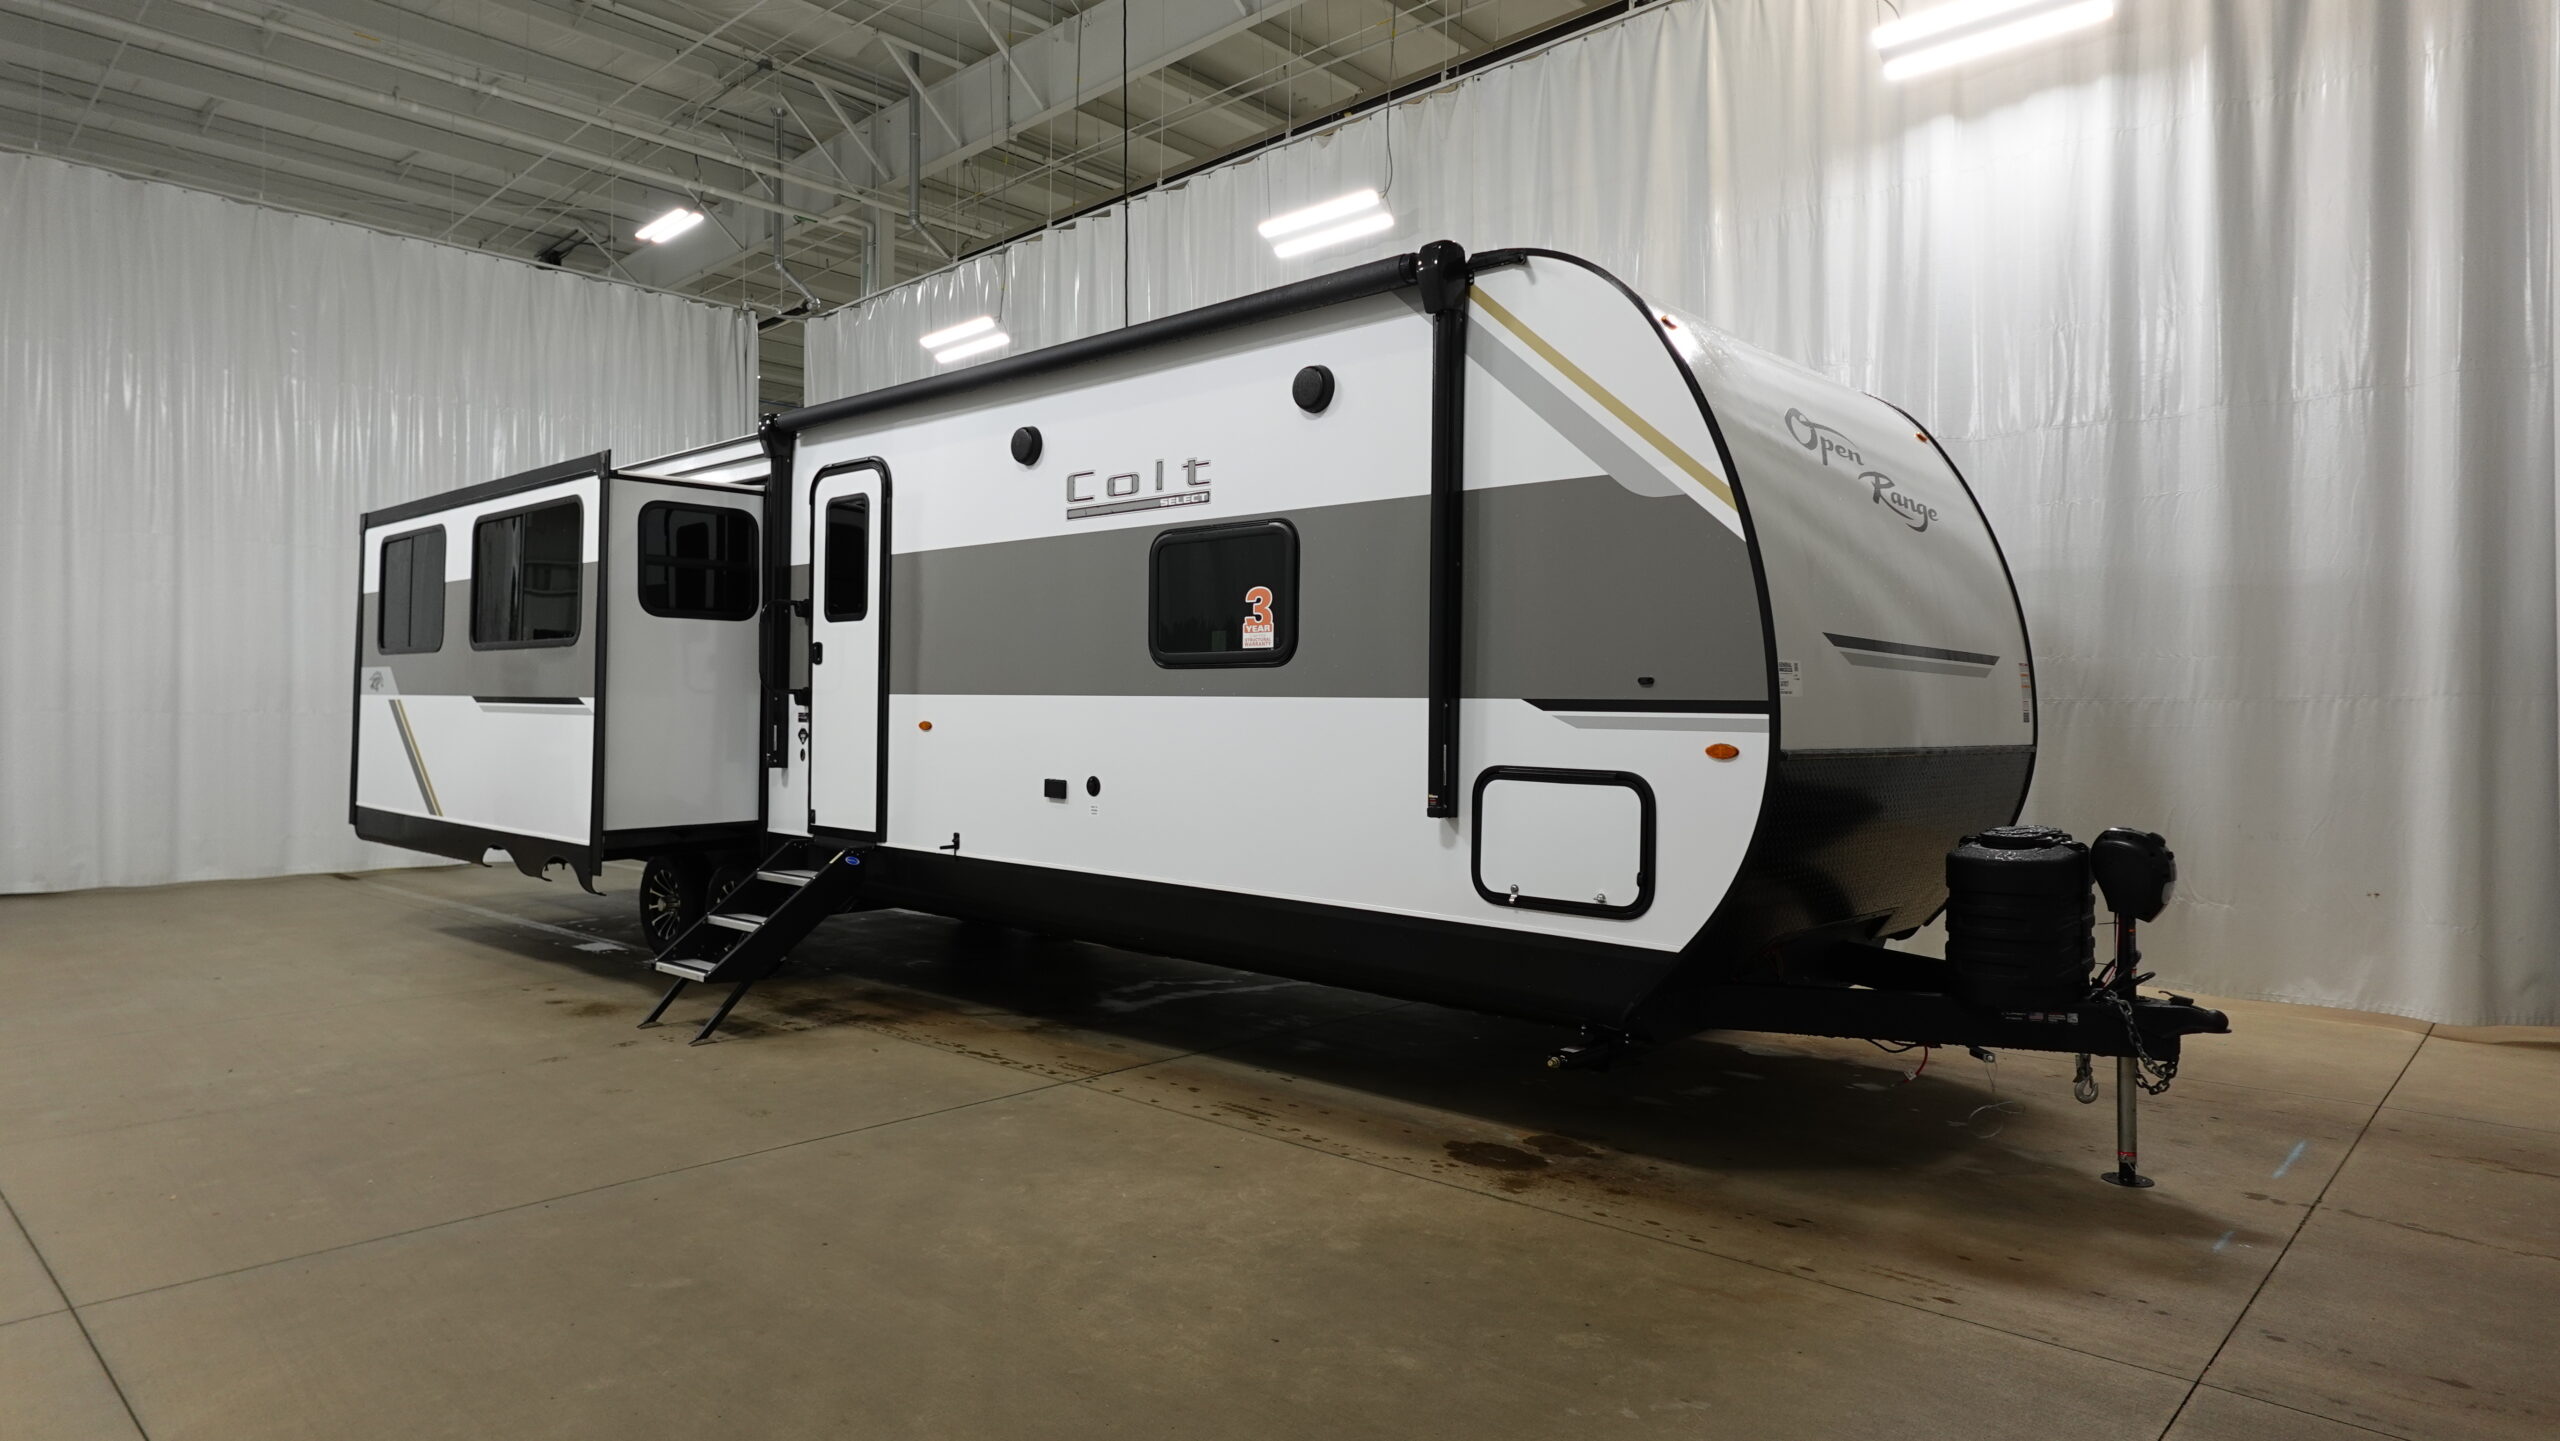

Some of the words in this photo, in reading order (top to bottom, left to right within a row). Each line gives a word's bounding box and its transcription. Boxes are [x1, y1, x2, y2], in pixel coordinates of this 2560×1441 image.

[1066, 458, 1211, 503] Colt
[1785, 408, 1864, 466] Open
[1858, 471, 1939, 533] Range
[1160, 493, 1208, 507] SELECT
[1245, 586, 1273, 625] 3
[1246, 624, 1271, 633] YEAR
